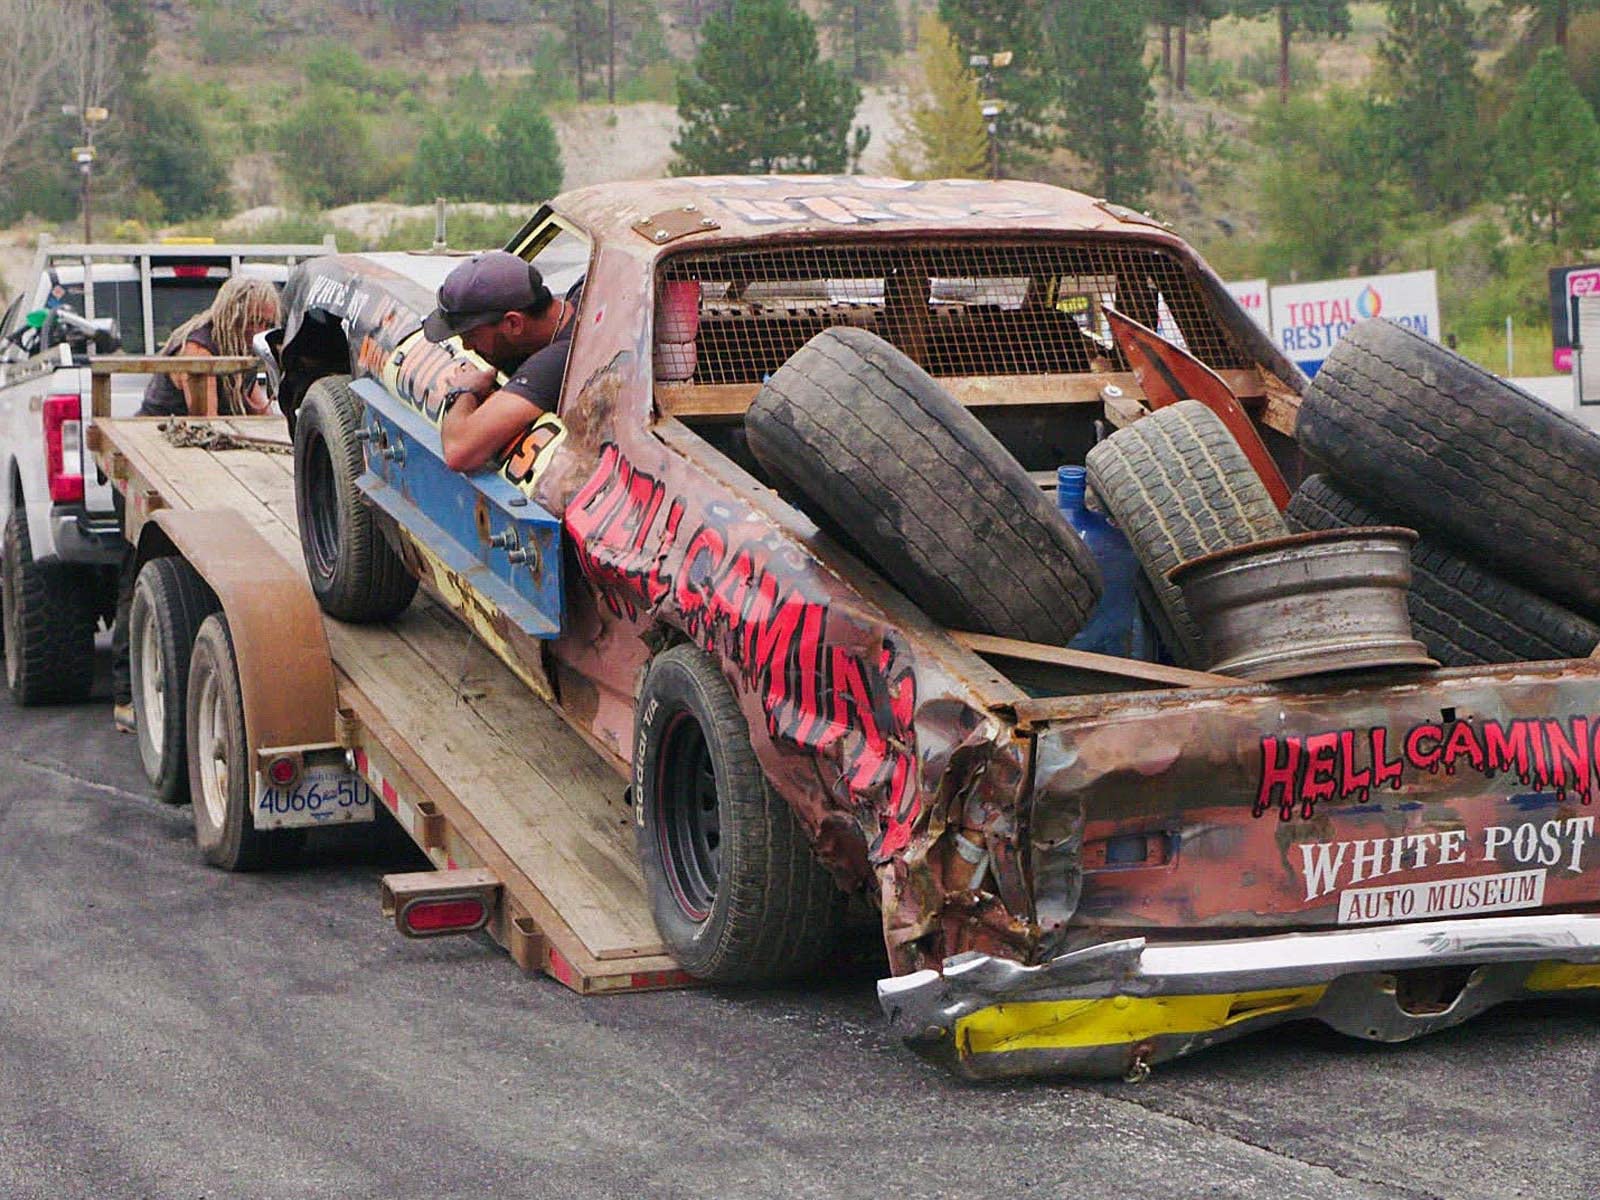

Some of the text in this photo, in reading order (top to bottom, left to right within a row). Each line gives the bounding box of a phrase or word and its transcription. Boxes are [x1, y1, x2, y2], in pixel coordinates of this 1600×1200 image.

[1287, 298, 1356, 328] TOTAL
[1299, 816, 1595, 902] WHITE POST
[1347, 873, 1538, 921] AUTO MUSEUM
